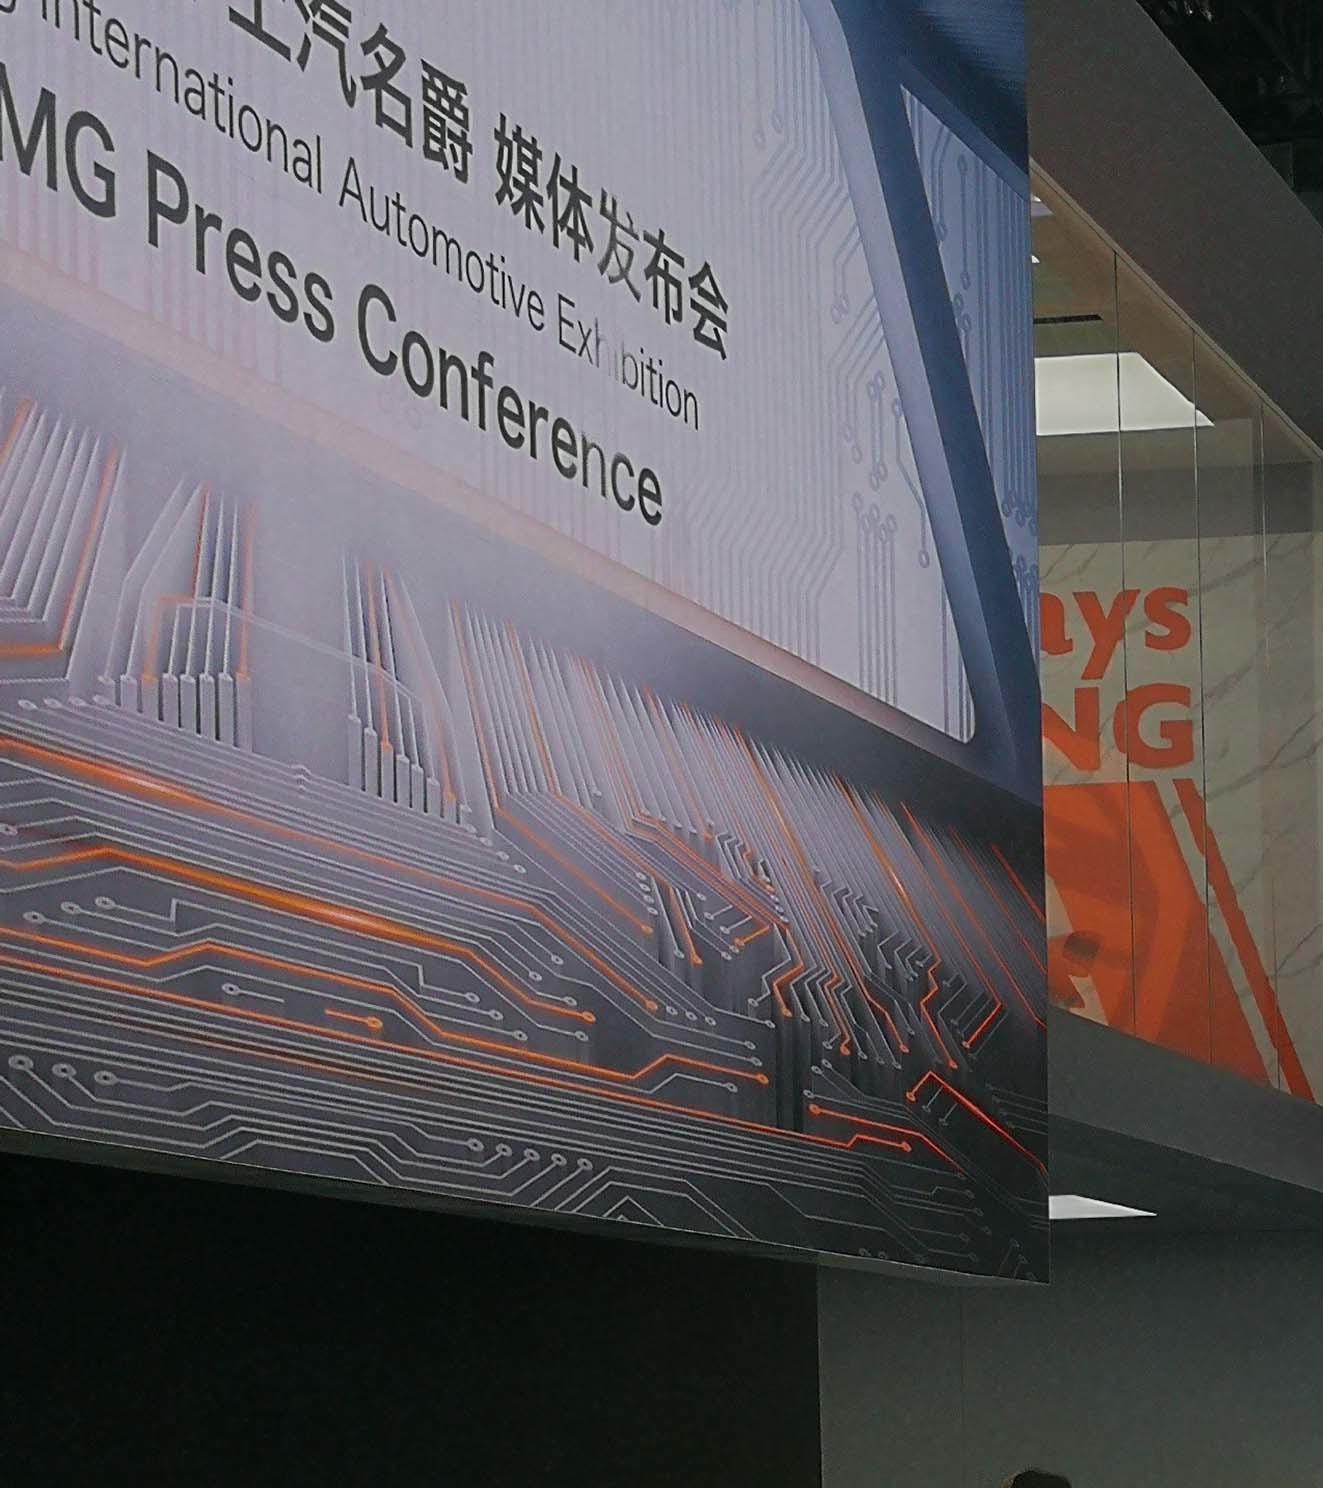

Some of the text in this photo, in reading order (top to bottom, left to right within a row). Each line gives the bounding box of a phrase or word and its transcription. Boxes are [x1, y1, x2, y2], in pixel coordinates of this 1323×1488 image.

[0, 60, 663, 526] MG Press Conference
[338, 157, 546, 332] Automotive
[494, 112, 728, 360] 媒体发布会
